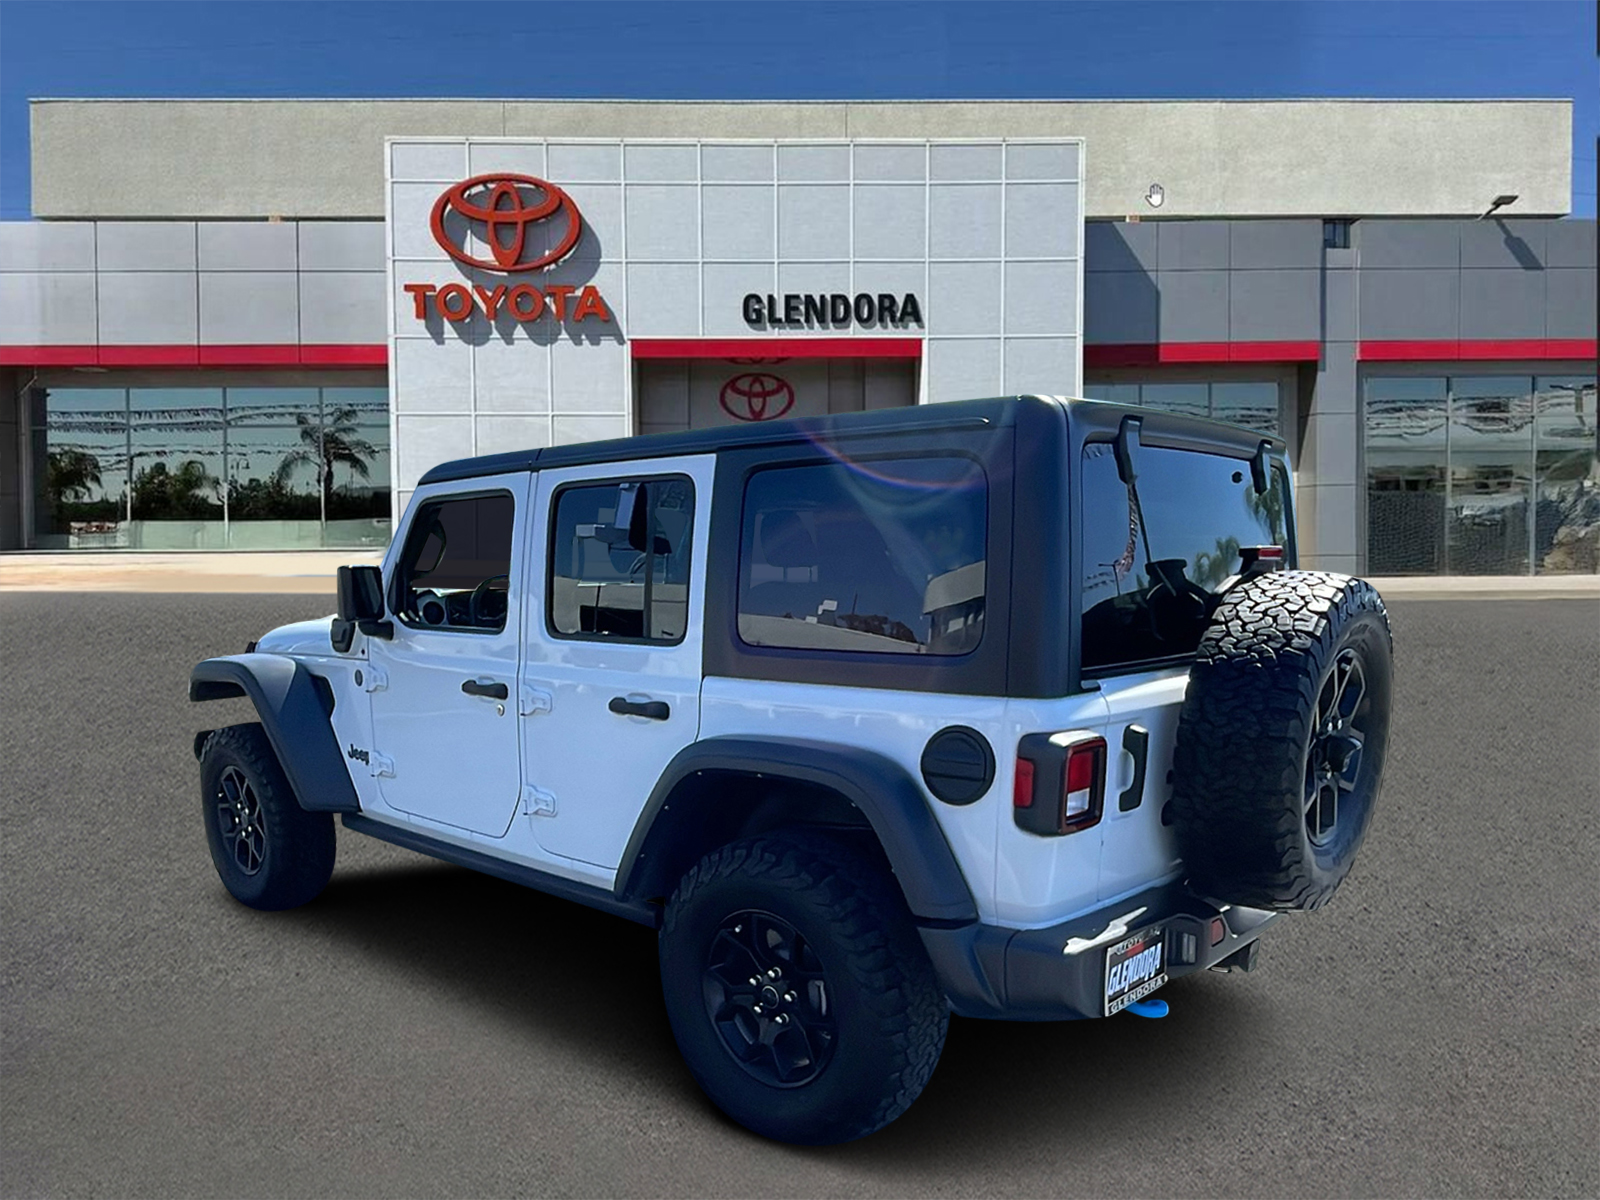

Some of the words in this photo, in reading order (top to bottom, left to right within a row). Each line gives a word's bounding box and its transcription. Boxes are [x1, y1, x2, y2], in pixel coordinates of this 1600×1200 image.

[404, 283, 610, 323] TOYOTA
[742, 293, 922, 325] GLENDORA
[347, 743, 370, 767] Jeep
[1108, 942, 1162, 996] GLENDORA
[1111, 979, 1163, 1013] GLENDORA
